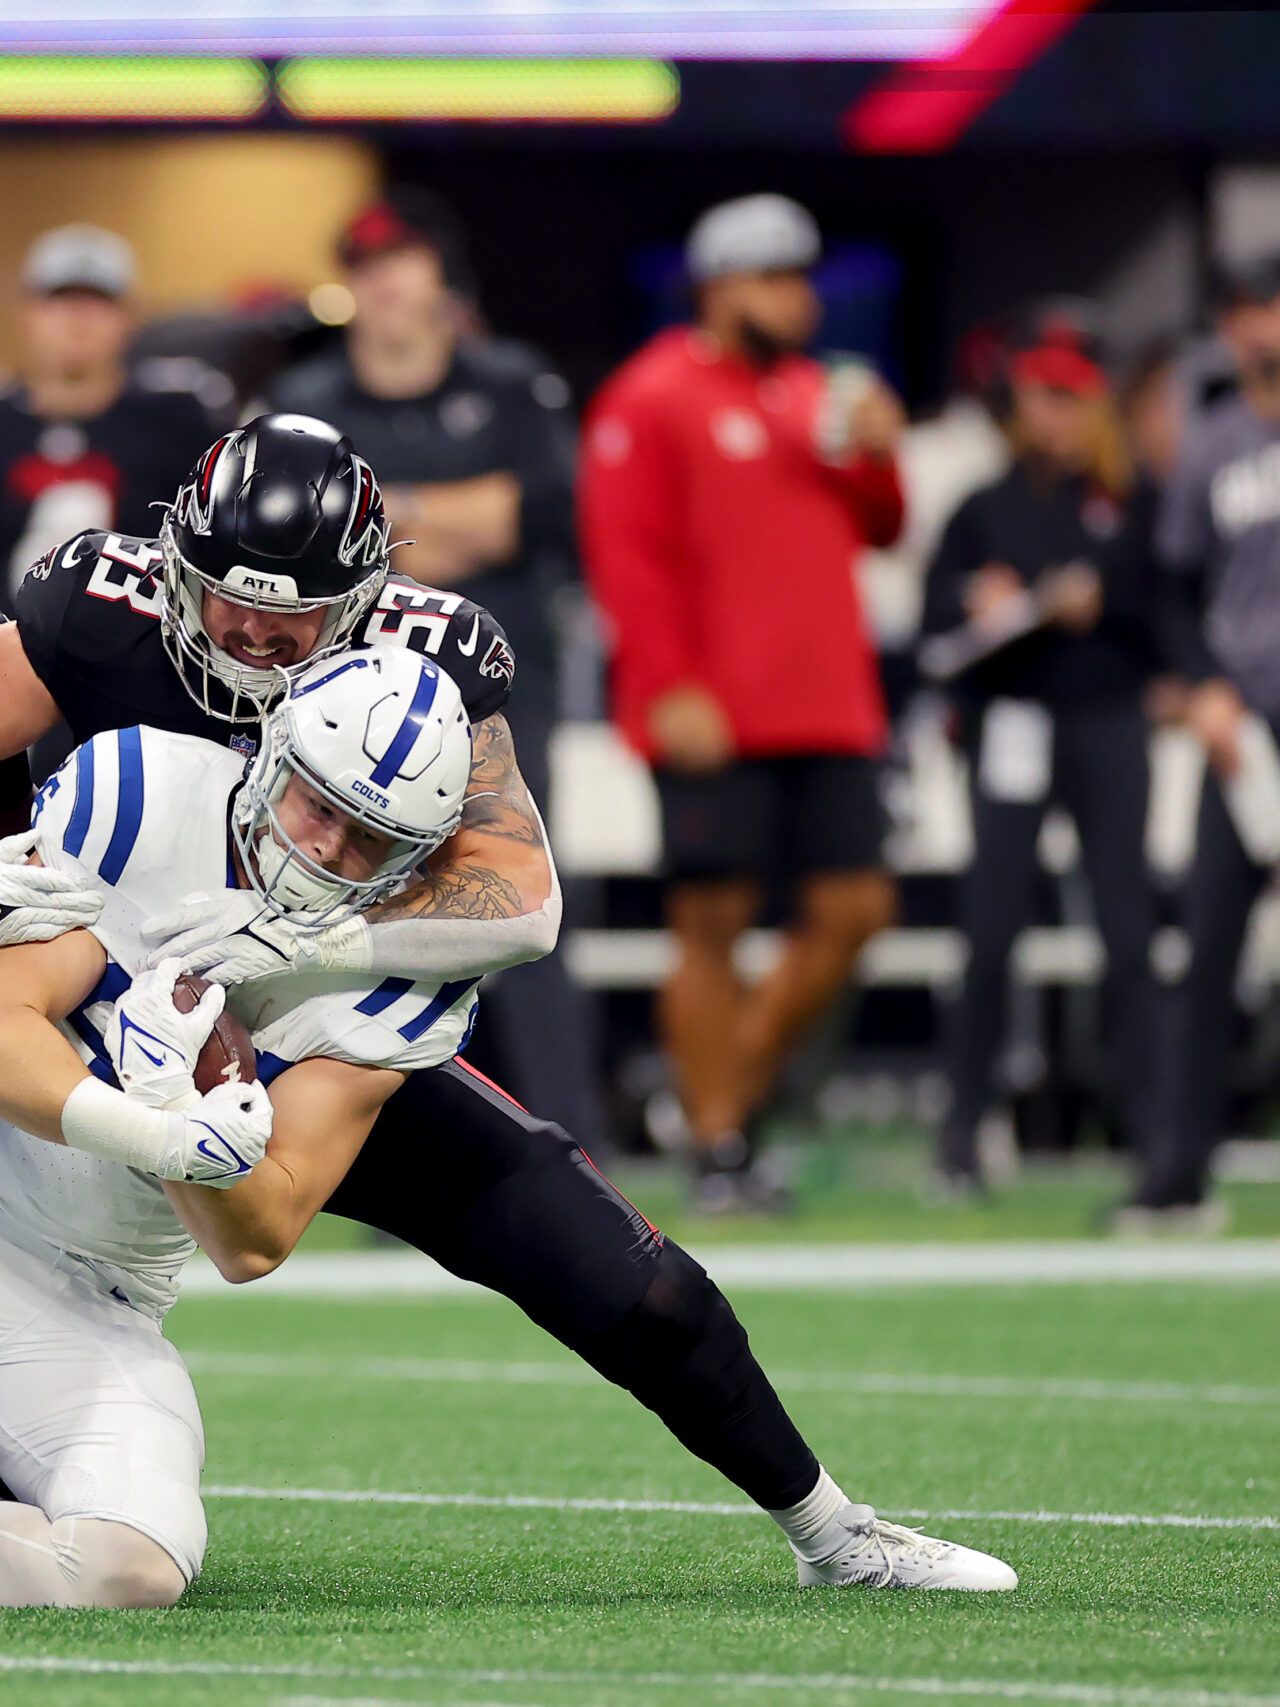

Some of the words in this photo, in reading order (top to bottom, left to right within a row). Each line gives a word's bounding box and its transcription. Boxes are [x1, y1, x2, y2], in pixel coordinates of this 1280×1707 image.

[242, 576, 279, 593] ATL
[363, 582, 466, 655] 53
[351, 780, 390, 809] COLTS
